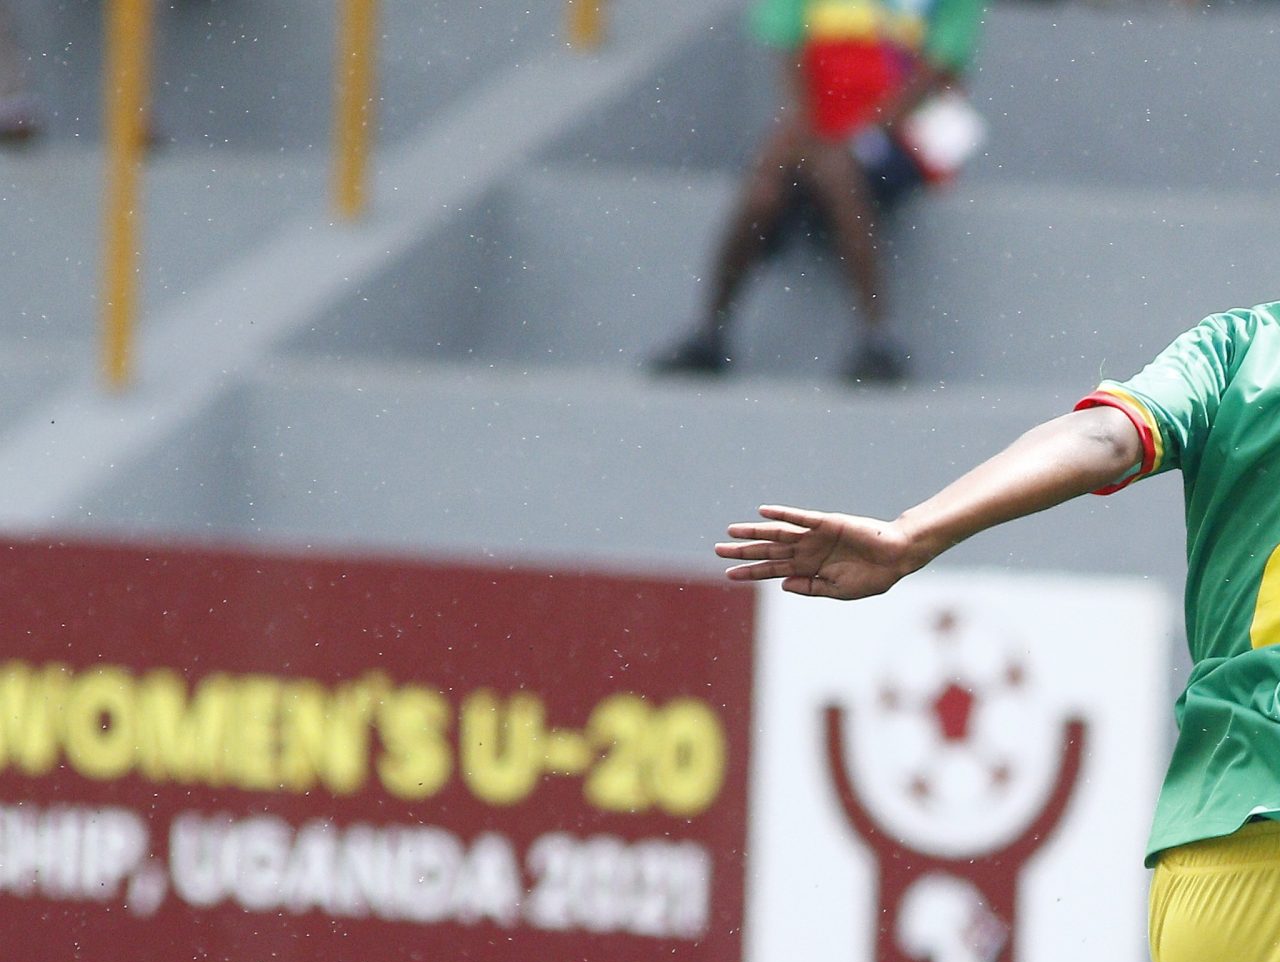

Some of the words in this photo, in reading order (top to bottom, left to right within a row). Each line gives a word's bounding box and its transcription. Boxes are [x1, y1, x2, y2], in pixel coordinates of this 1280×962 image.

[0, 660, 453, 799] WOMEN'S
[460, 690, 727, 816] U-20
[0, 804, 167, 917] HIP,
[168, 811, 523, 928] UGANDA
[525, 830, 711, 939] 2021
